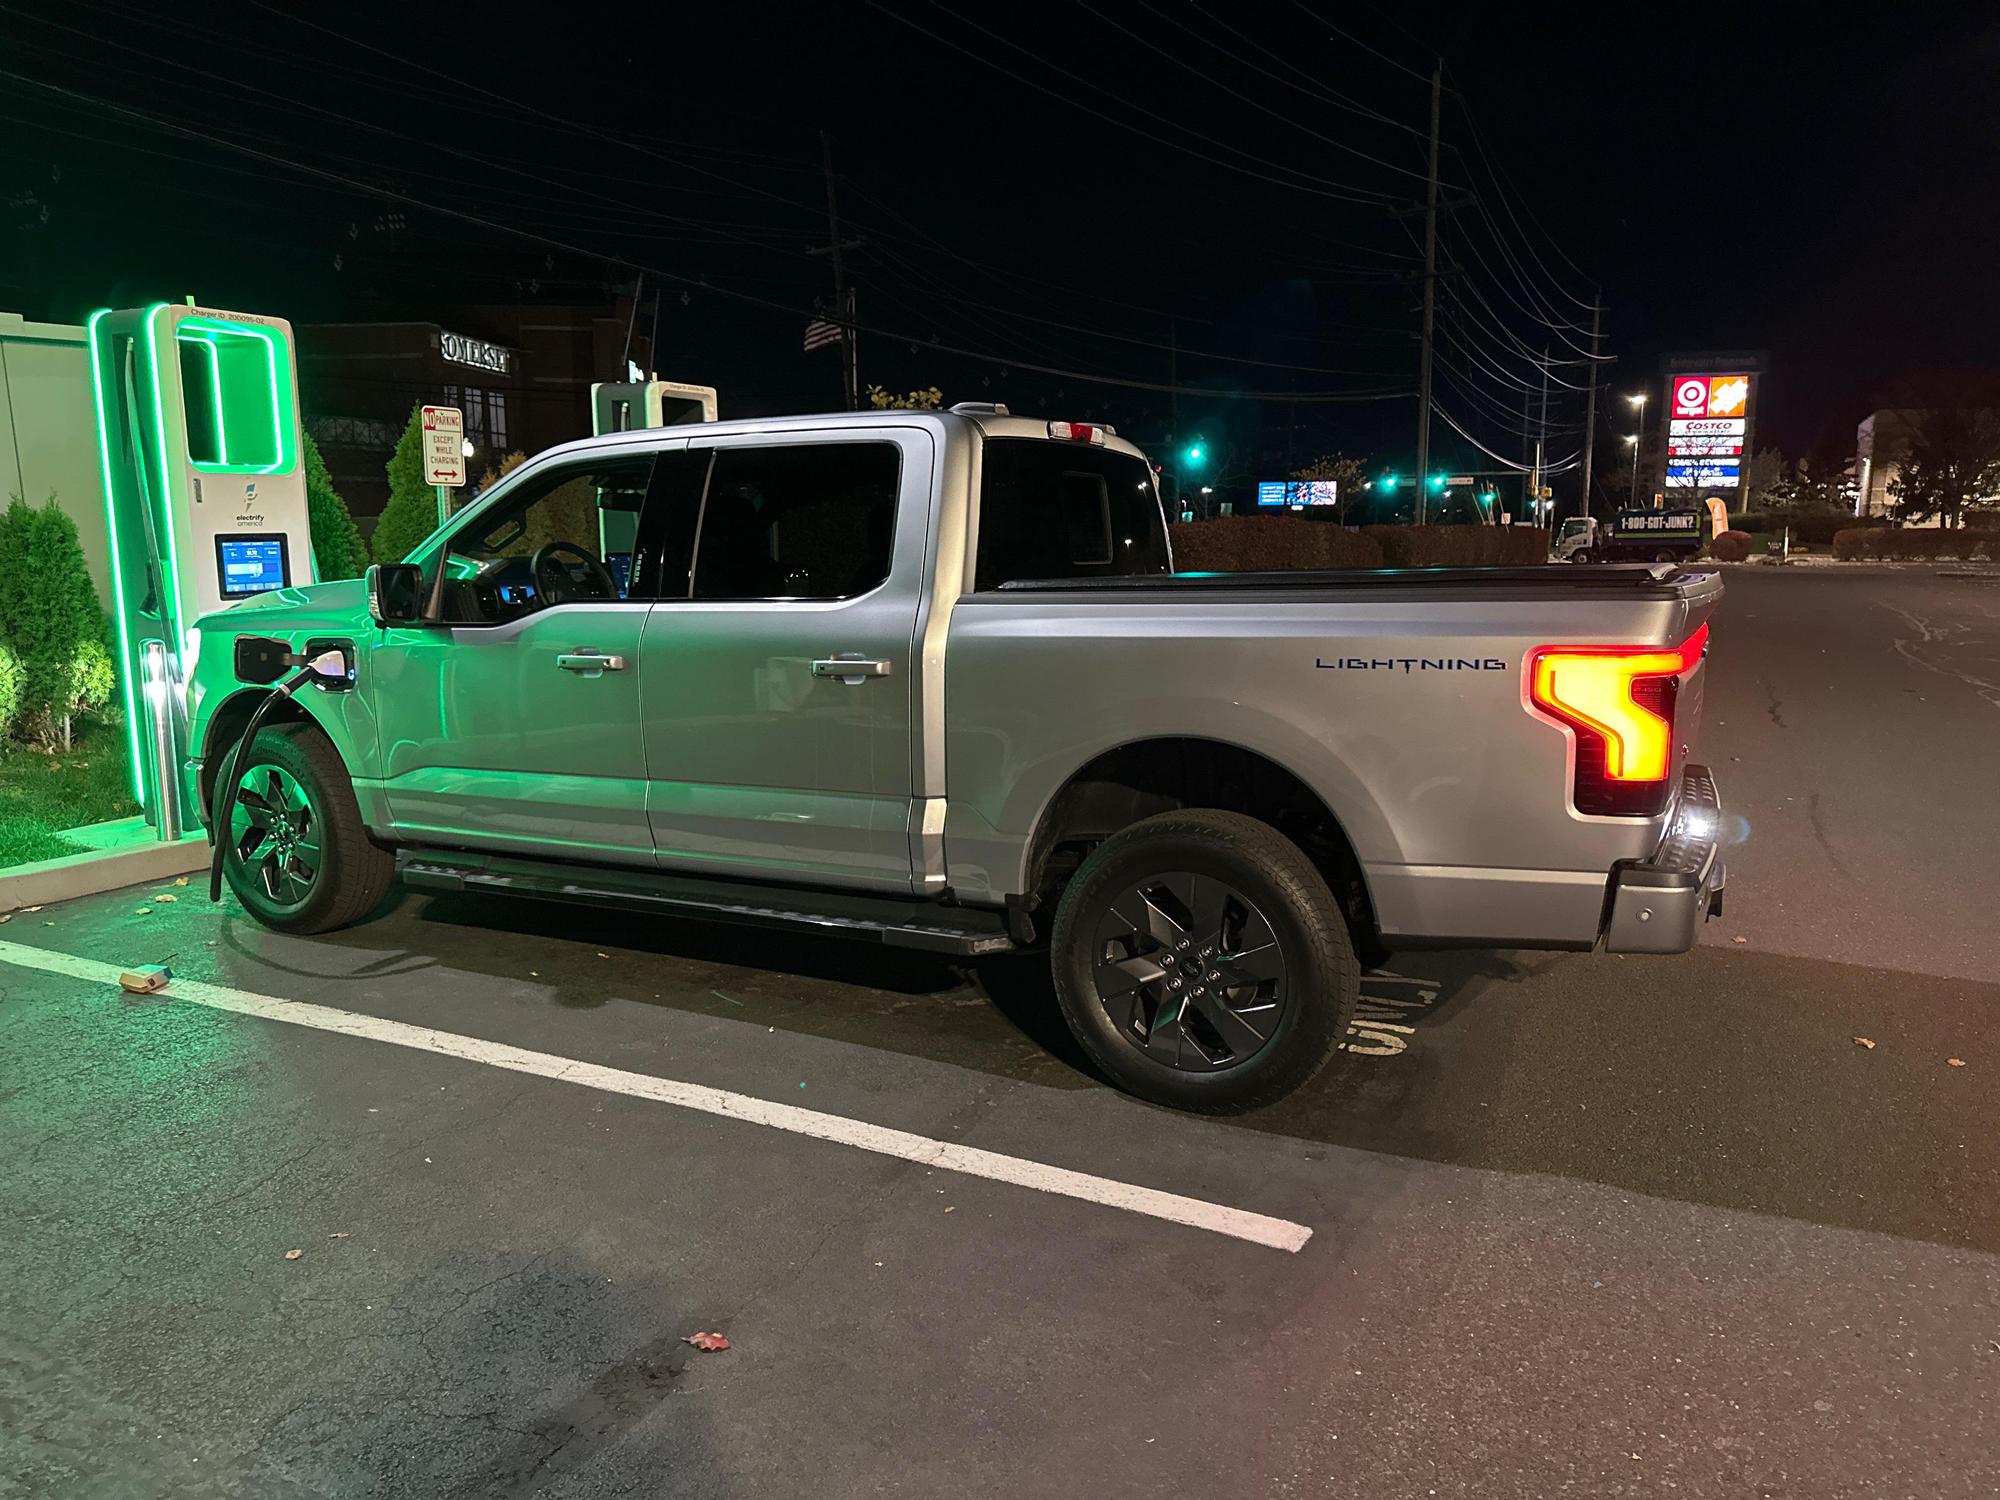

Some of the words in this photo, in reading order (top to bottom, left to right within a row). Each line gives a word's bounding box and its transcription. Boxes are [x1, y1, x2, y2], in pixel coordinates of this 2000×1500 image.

[191, 308, 217, 318] Charger
[424, 411, 435, 427] NO
[435, 415, 460, 426] PARKING
[1686, 422, 1732, 430] COSTCO
[433, 435, 454, 444] EXCEPT
[435, 446, 453, 455] WHILE
[430, 456, 459, 465] CHARGING
[1315, 658, 1506, 674] LIGHTNING
